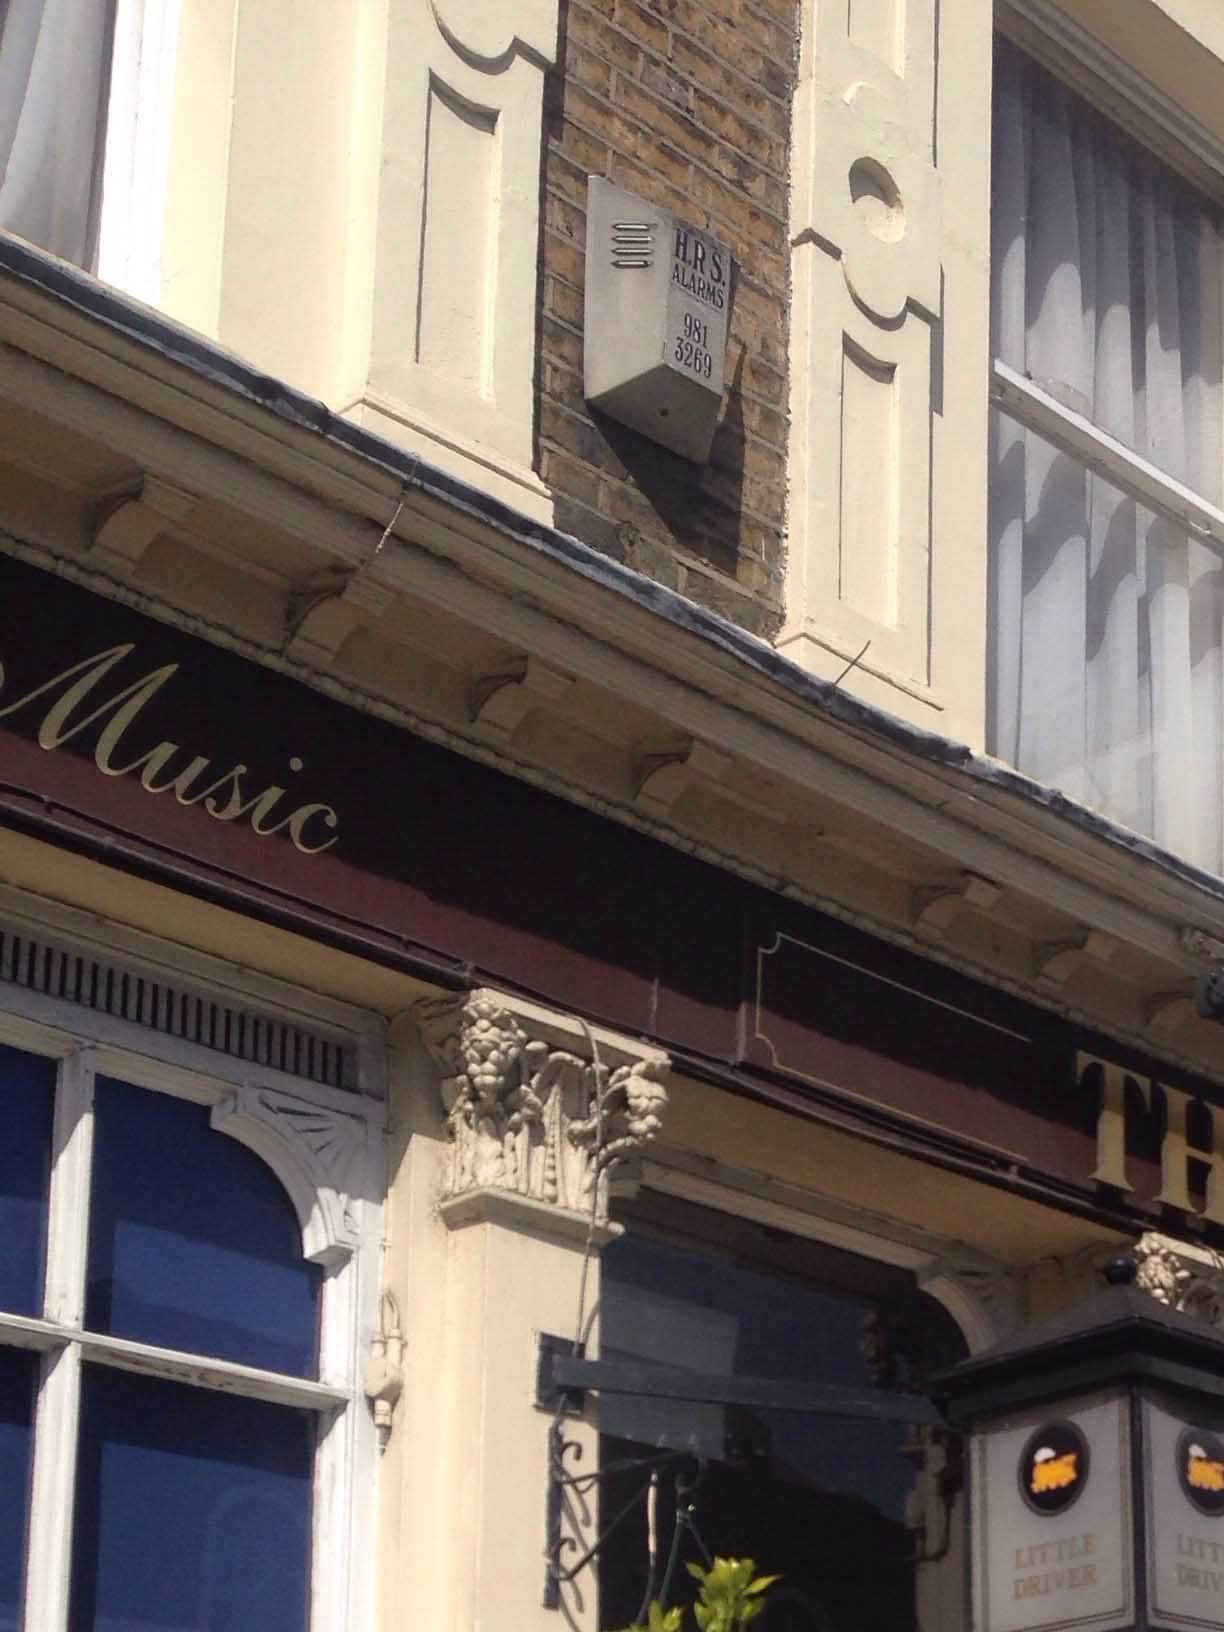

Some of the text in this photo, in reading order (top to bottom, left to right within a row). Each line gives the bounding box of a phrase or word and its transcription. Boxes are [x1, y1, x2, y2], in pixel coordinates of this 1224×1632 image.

[672, 263, 724, 309] ALARMS
[684, 312, 708, 349] 981
[675, 336, 712, 379] 3269
[0, 642, 339, 853] Music
[1014, 1533, 1095, 1570] LITTLE
[1013, 1564, 1096, 1600] DRIVER
